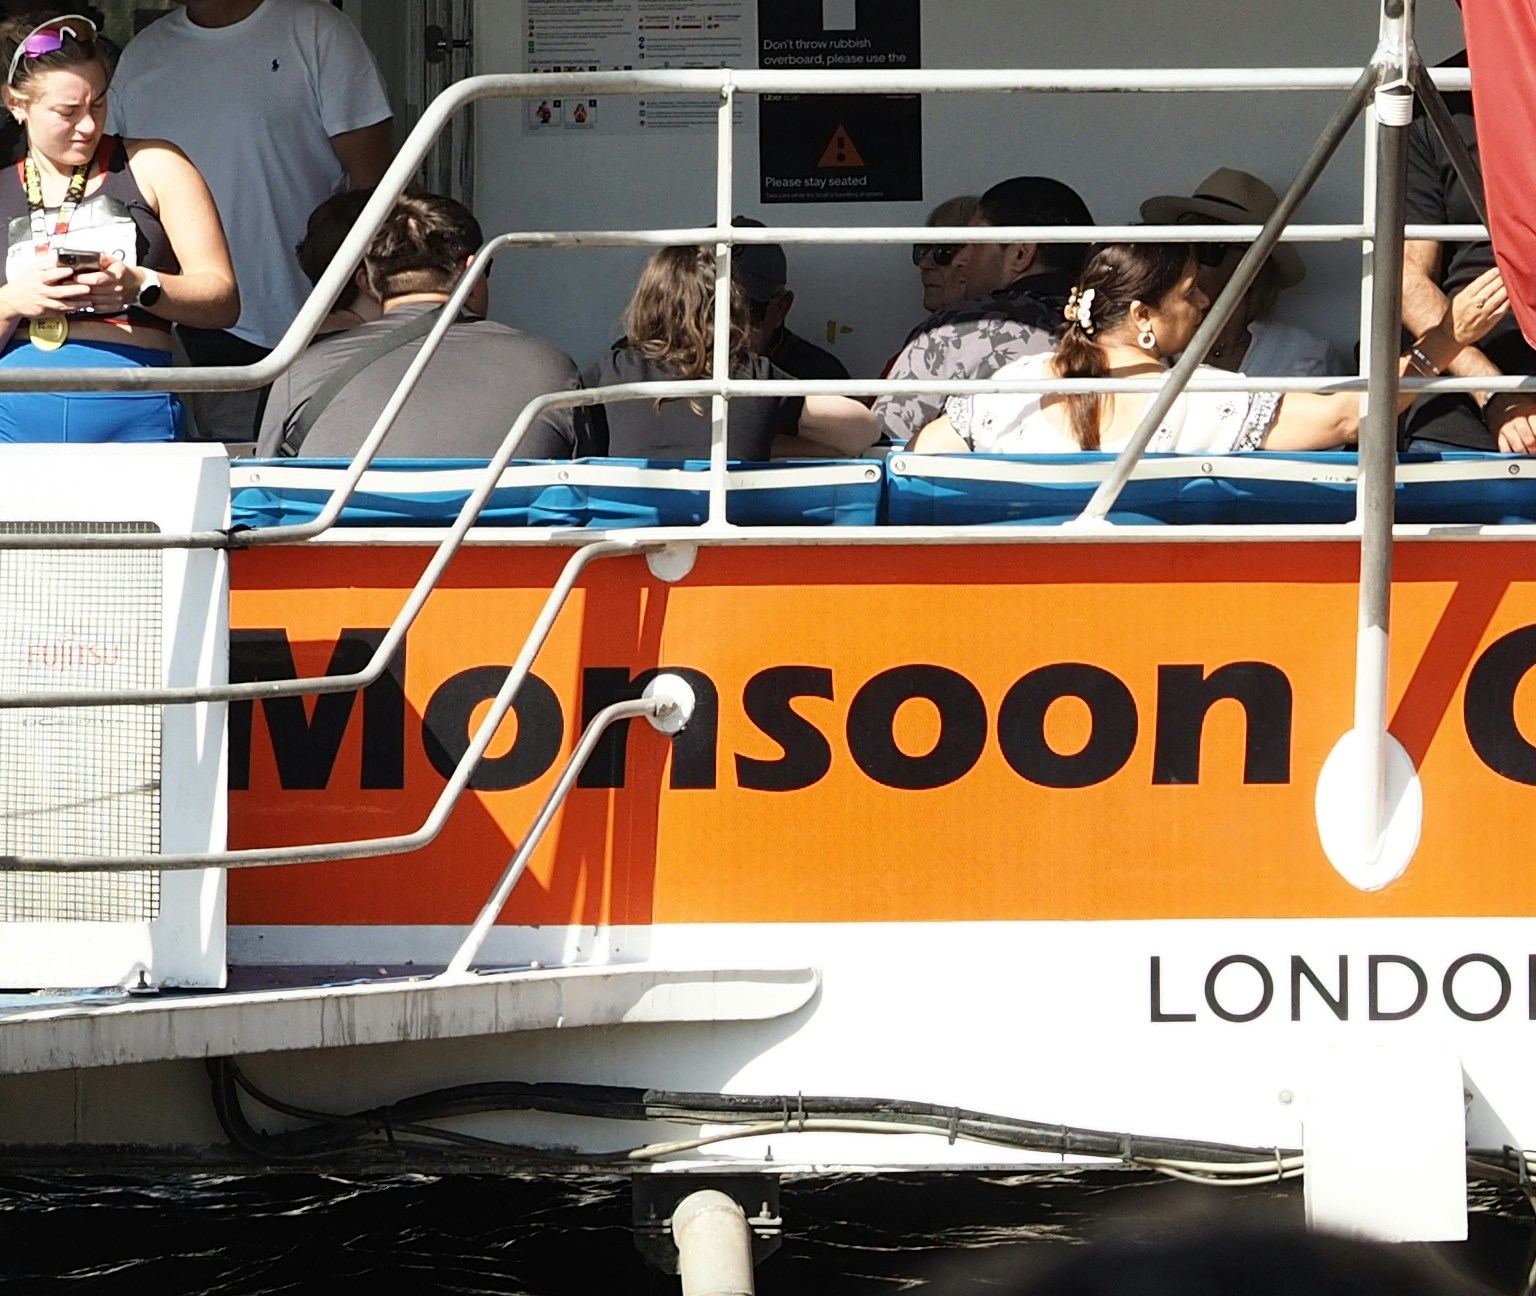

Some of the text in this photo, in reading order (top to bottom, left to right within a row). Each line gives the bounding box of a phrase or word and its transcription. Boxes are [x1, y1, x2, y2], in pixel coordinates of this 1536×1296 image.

[763, 38, 871, 50] Don't throw rubbish
[763, 52, 907, 66] overboard, please use the
[765, 175, 867, 189] Please stay seated
[27, 641, 121, 672] FUJITSU
[228, 627, 1293, 792] Monsoon
